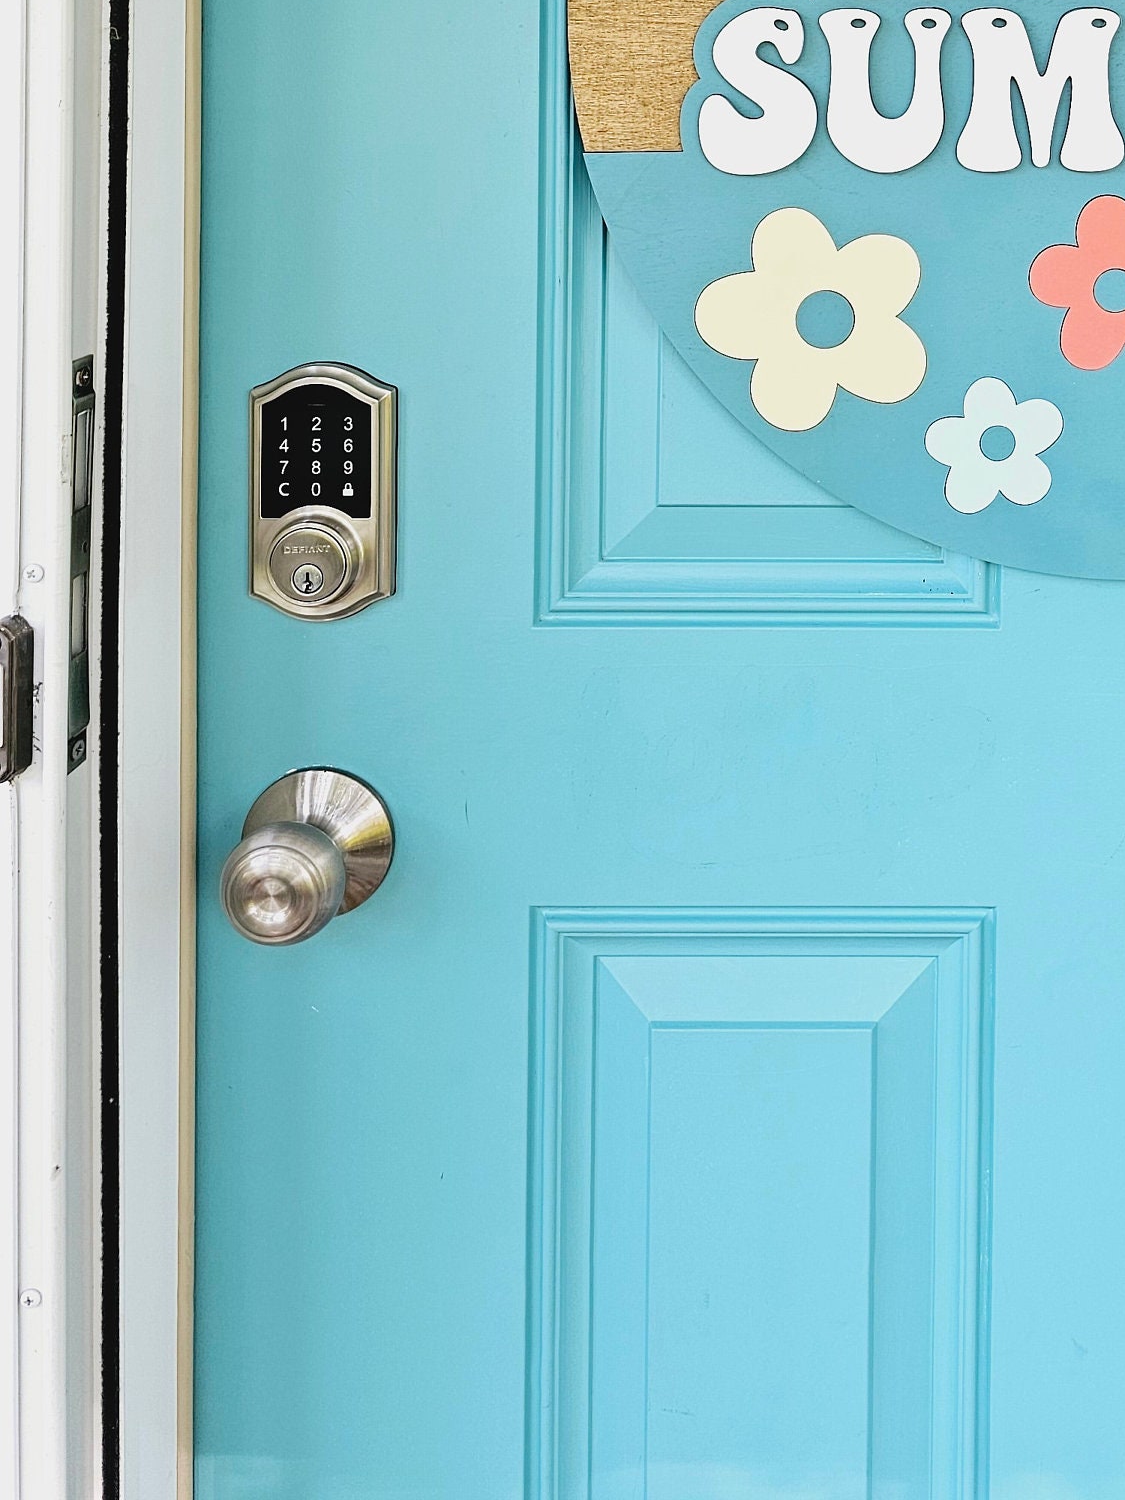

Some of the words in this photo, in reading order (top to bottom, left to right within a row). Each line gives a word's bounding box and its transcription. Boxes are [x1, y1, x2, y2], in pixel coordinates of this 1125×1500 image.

[279, 416, 288, 431] 1
[311, 416, 322, 431] 2
[343, 416, 354, 431] 3
[278, 438, 290, 453] 4
[311, 438, 322, 453] 5
[343, 438, 354, 453] 6
[279, 460, 290, 475] 7
[311, 460, 322, 475] 8
[343, 460, 354, 475] 9
[278, 482, 290, 497] C
[310, 482, 321, 497] 0
